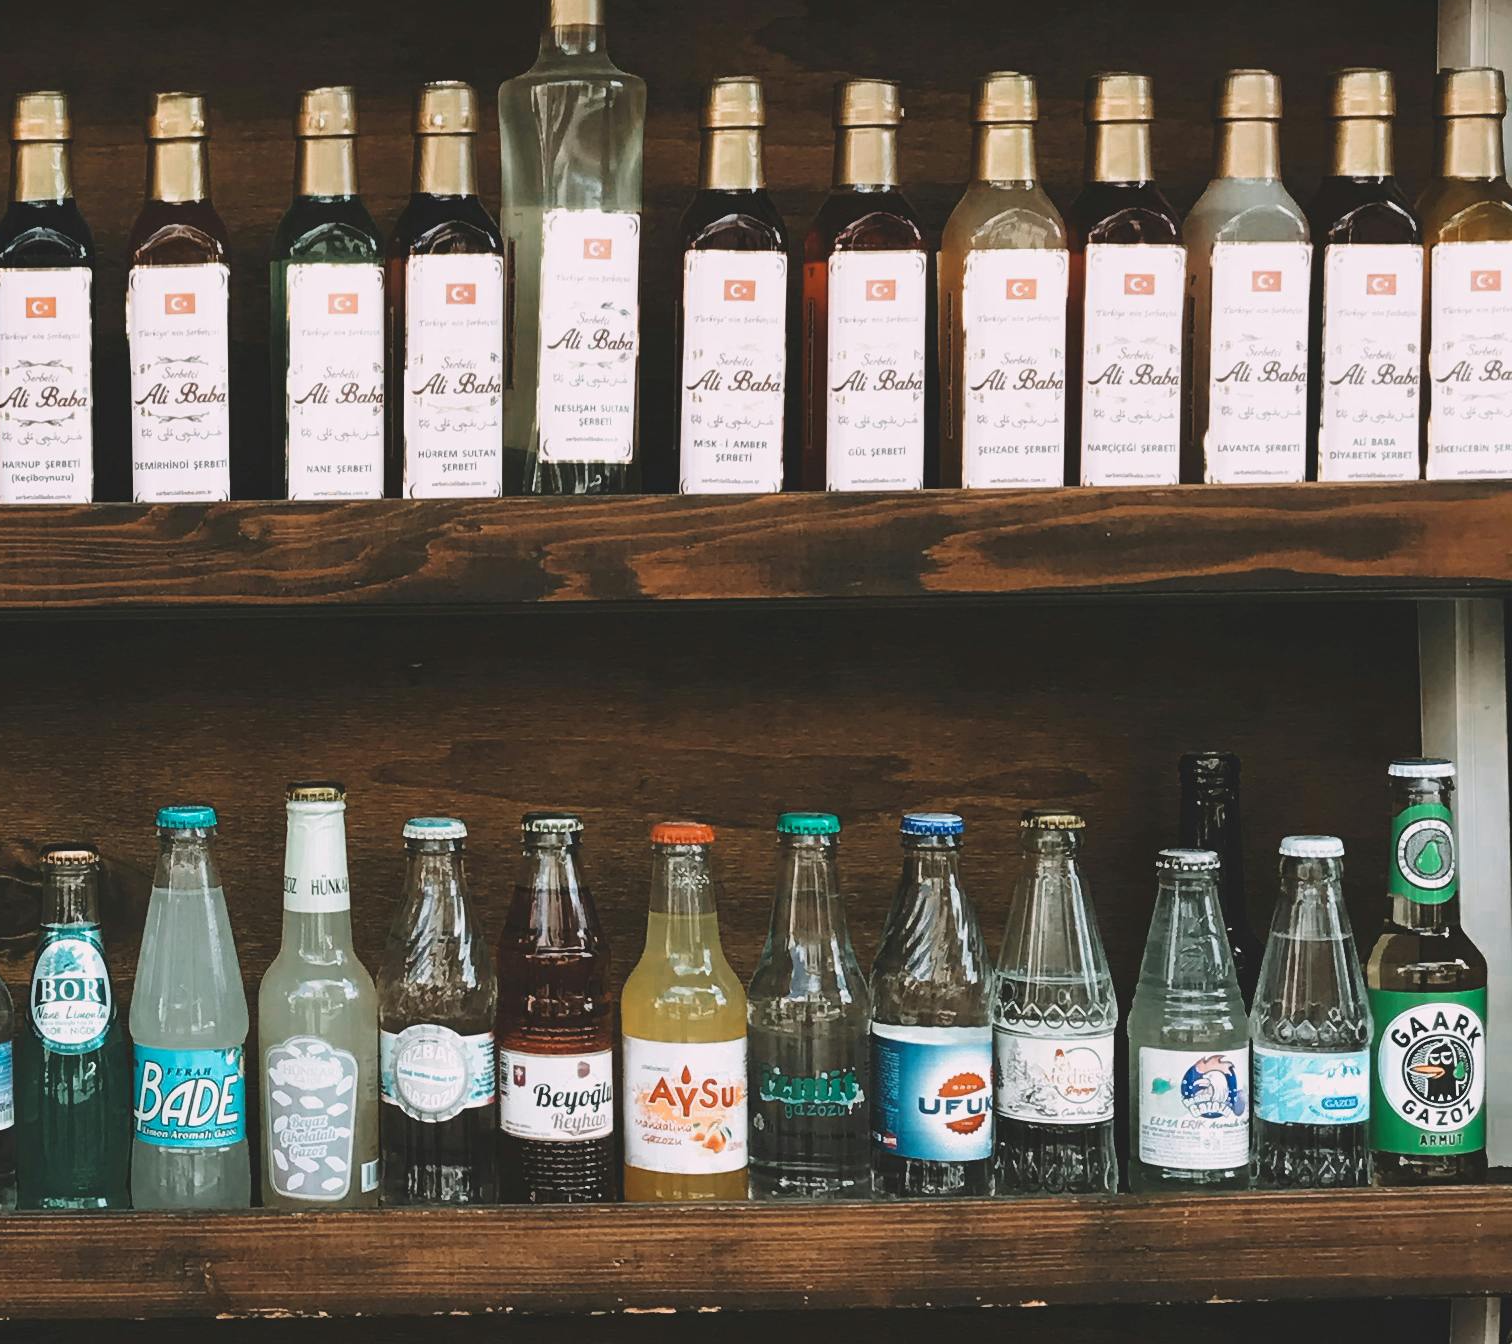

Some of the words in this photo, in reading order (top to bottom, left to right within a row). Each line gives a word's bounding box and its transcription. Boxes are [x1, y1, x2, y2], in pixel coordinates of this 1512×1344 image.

[686, 370, 721, 394] Ali
[728, 370, 780, 392] Baba
[831, 370, 867, 394] Ali
[873, 368, 924, 394] Baba
[970, 369, 1006, 391] Ali
[1013, 367, 1065, 392] Baba
[1088, 364, 1123, 385] Ali
[1130, 362, 1181, 388] Baba
[1214, 361, 1250, 385] Ali
[1258, 360, 1307, 385] Baba
[36, 386, 87, 408] Baba
[293, 383, 328, 406] Ali
[336, 381, 384, 406] Baba
[848, 447, 866, 456] GÜL
[871, 446, 905, 457] ŞERBETİ
[1025, 444, 1059, 455] ŞERBETİ
[2, 461, 40, 469] HARNUP
[45, 459, 80, 470] ŞERBETİ
[337, 464, 371, 474] ŞERBETİ
[39, 979, 102, 1003] BOR
[1391, 1009, 1483, 1050] GAARK
[166, 1066, 212, 1078] FERAH
[134, 1060, 240, 1136] BADE
[532, 1082, 614, 1115] Beyoğlu
[918, 1097, 994, 1115] UFUK
[550, 1110, 607, 1132] Reyhan
[785, 1100, 847, 1120] gazozu
[1400, 1097, 1476, 1128] GAZOZ
[142, 1128, 169, 1140] Limon
[171, 1127, 213, 1140] Aromalı
[1419, 1132, 1464, 1147] ARMUT
[289, 1144, 329, 1161] Gazoz
